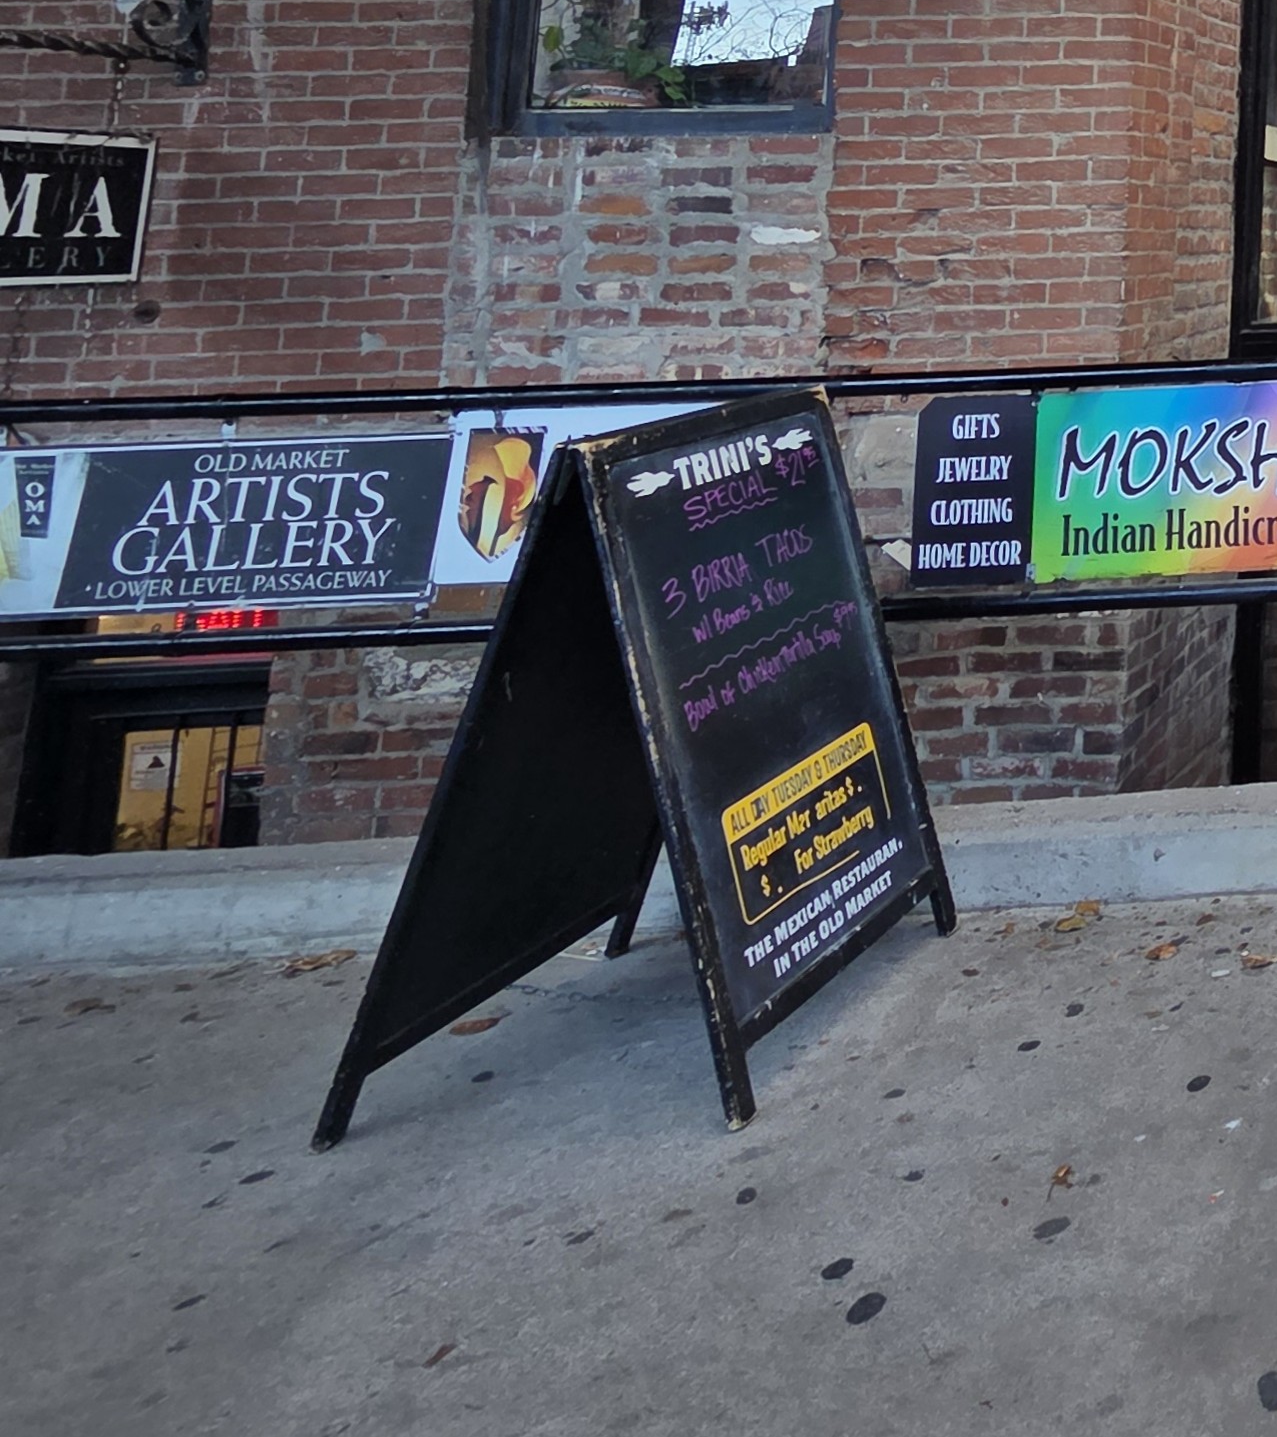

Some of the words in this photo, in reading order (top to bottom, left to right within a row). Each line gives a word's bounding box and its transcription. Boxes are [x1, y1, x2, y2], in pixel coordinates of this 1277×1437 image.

[952, 413, 1000, 440] GIFTS
[194, 453, 247, 474] OLD
[250, 448, 350, 472] MARKET
[673, 434, 773, 491] TRINI'S
[936, 455, 1012, 484] JEWELRY
[137, 470, 390, 527] ARTISTS
[684, 469, 778, 520] SPECIAL
[930, 497, 1013, 526] CLOTHING
[112, 517, 397, 575] GALLERY
[918, 543, 967, 570] HOME
[969, 540, 1022, 568] DECOR
[1061, 510, 1158, 557] Indian
[94, 577, 174, 600] LOWER
[179, 574, 248, 596] LEVEL
[251, 569, 392, 594] PASSAGEWAY
[661, 576, 687, 620] 3
[692, 552, 753, 602] BIRRIA
[755, 524, 813, 566] TACOS
[713, 604, 750, 635] Beans
[684, 684, 718, 732] Bowl
[731, 803, 752, 837] ALL
[771, 767, 813, 805] TUESDAY
[823, 730, 868, 774] THURSDAY
[740, 828, 787, 871] Regular
[794, 848, 815, 880] For
[813, 805, 875, 860] Strawberry
[743, 934, 775, 968] THE
[774, 890, 832, 946] MEXICAN
[832, 836, 904, 900] RESTAURAN
[773, 951, 791, 979] IN
[791, 934, 819, 963] THE
[819, 909, 845, 940] OLD
[846, 870, 893, 919] MARKET
